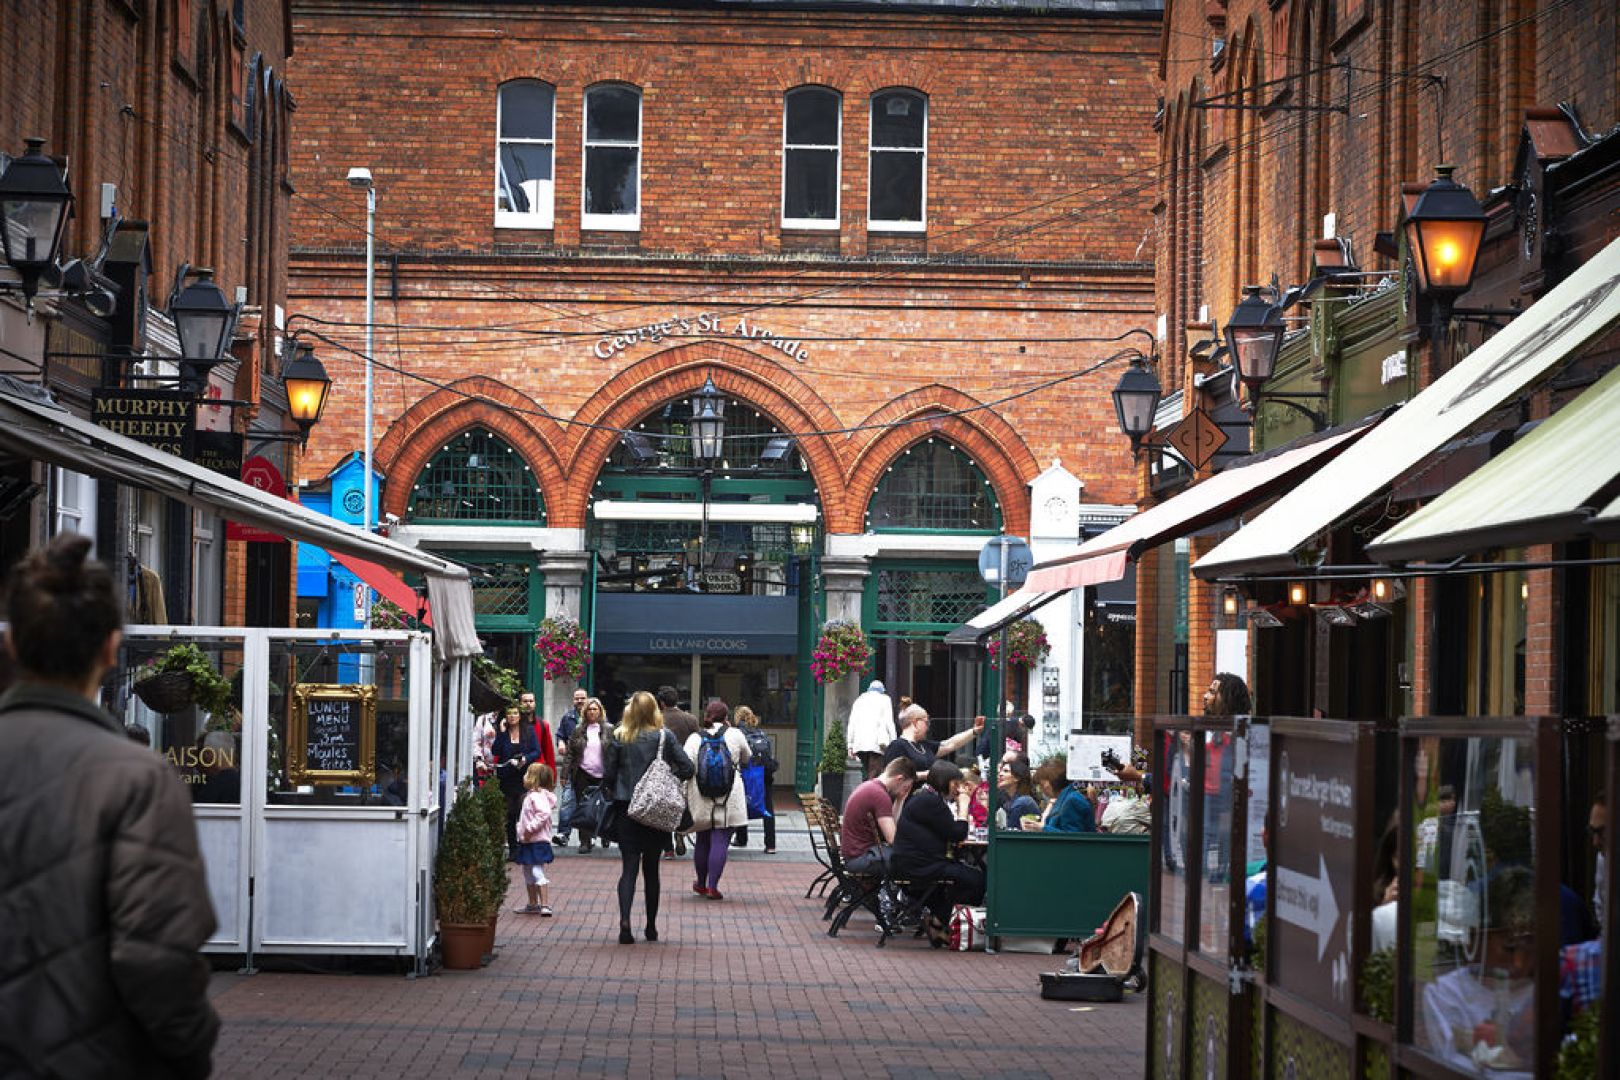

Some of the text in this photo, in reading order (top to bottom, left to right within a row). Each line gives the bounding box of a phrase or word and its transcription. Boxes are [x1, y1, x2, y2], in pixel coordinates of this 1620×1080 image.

[594, 312, 809, 362] George's St. Arcade
[96, 398, 189, 416] MURPHY
[650, 639, 683, 649] LOLLY
[707, 639, 746, 649] COOKS
[308, 701, 350, 715] LUNCH
[316, 714, 349, 725] MENU
[307, 745, 348, 759] Moules
